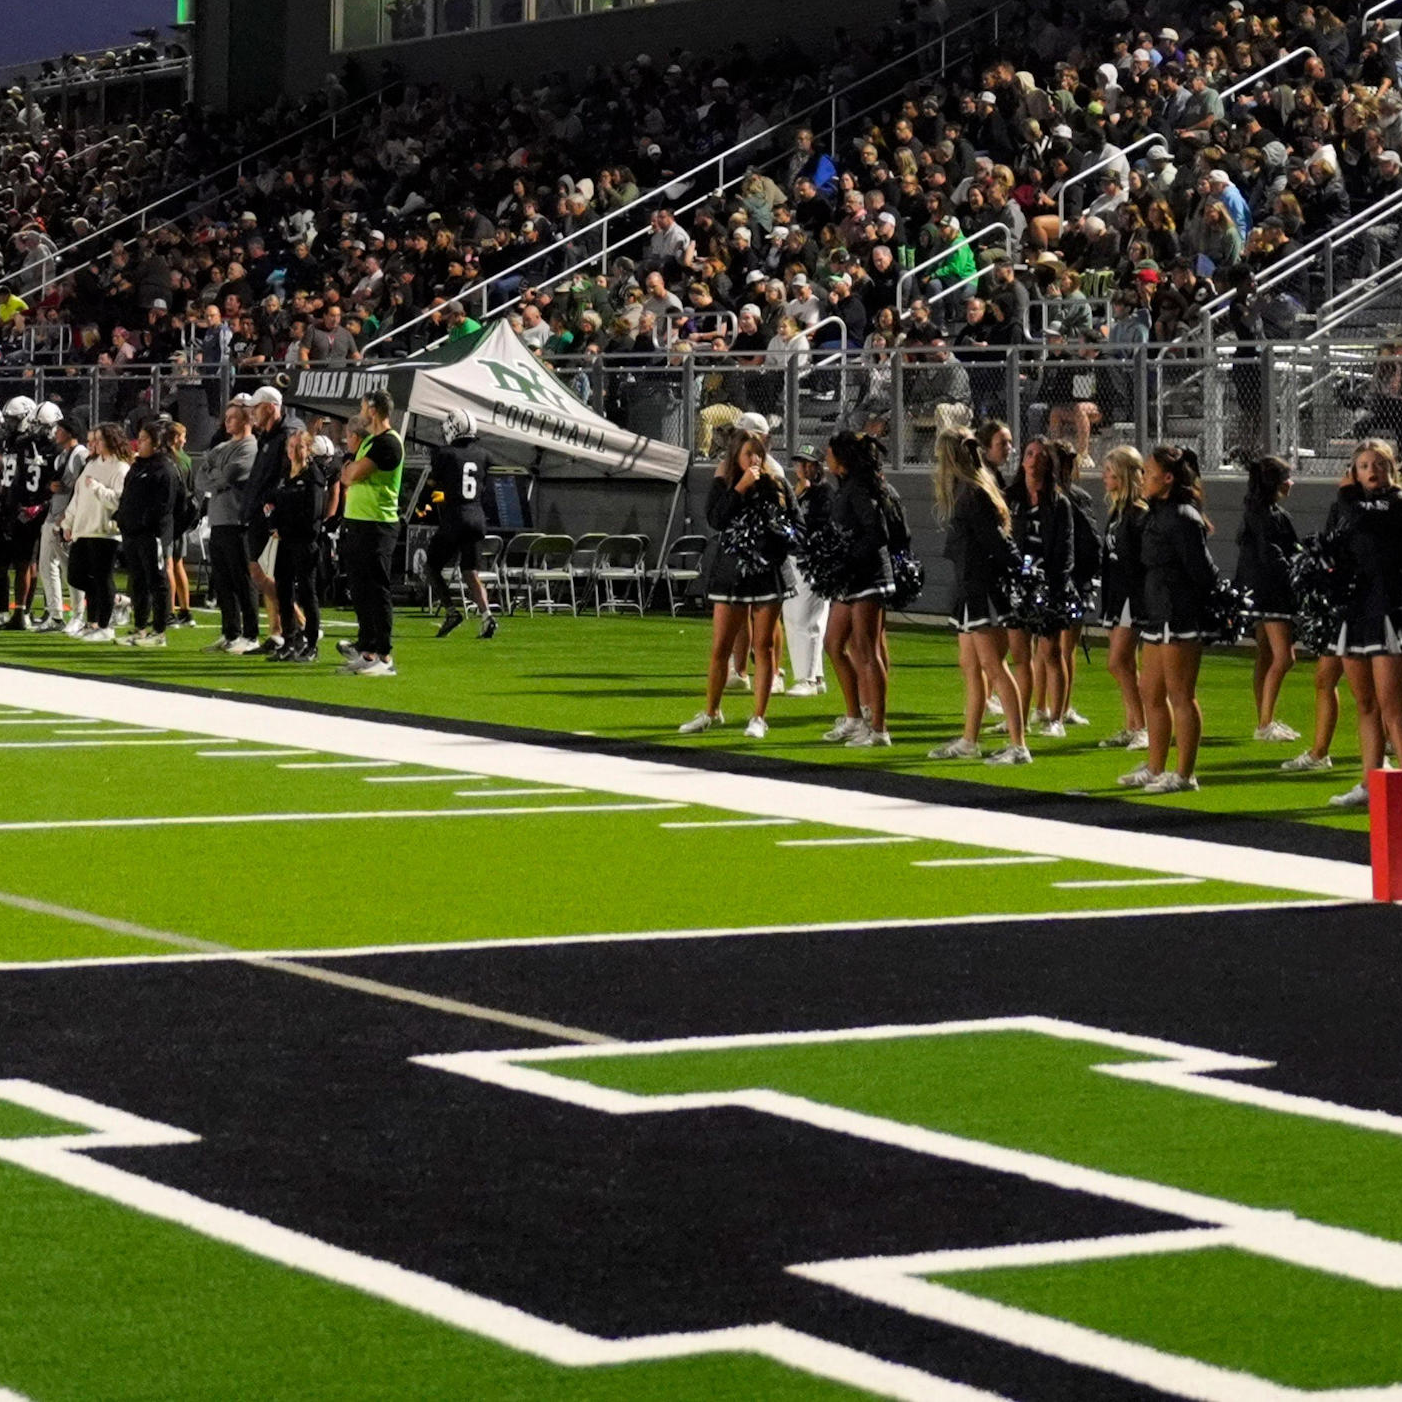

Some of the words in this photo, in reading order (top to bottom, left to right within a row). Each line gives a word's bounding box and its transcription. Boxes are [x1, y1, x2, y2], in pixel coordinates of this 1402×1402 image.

[296, 371, 348, 398] NORMAN
[493, 400, 607, 454] FOOTBALL
[25, 465, 41, 493] 3
[461, 461, 478, 500] 6
